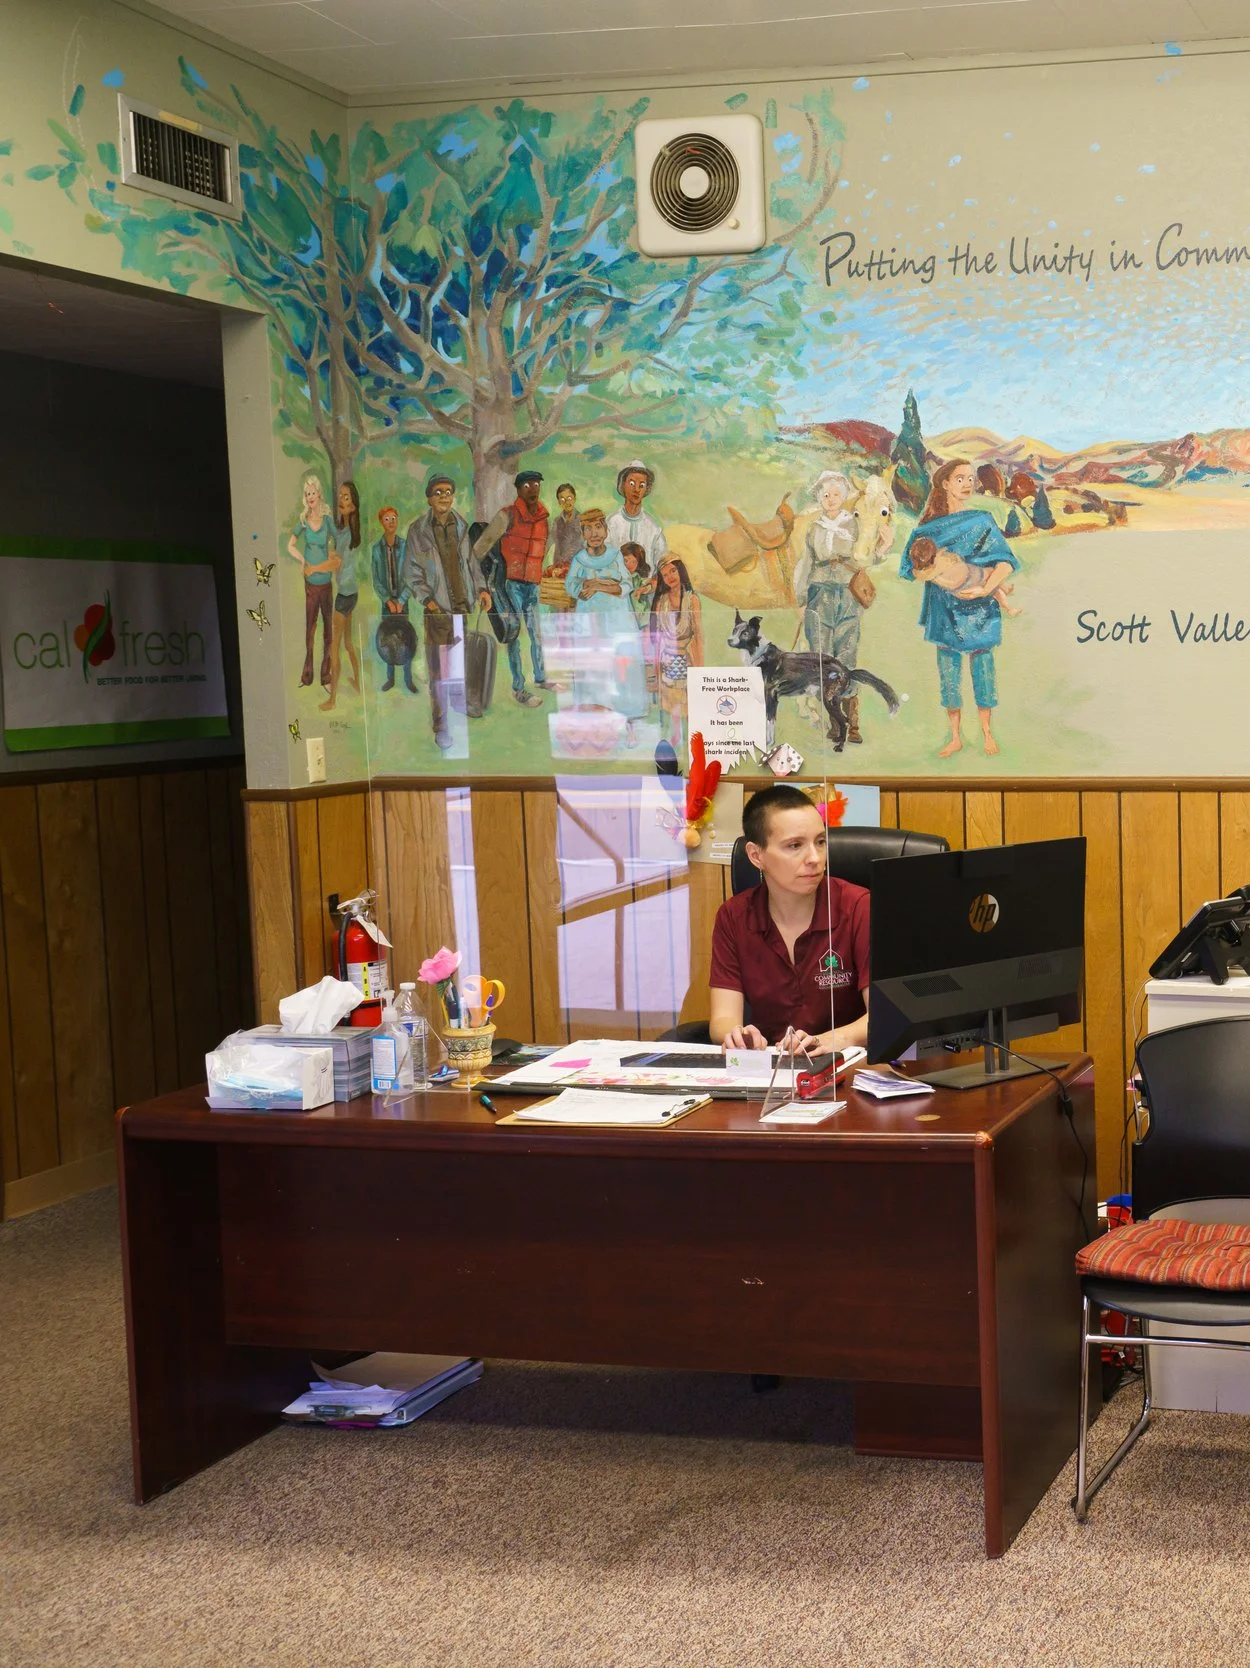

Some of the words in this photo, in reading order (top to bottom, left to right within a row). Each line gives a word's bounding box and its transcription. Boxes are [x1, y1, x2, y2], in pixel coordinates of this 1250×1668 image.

[820, 231, 936, 287] Putting
[948, 242, 998, 276] the
[1008, 236, 1095, 282] Unity
[1110, 240, 1143, 272] in
[14, 620, 71, 670] cal
[119, 620, 206, 667] fresh
[1076, 609, 1152, 644] Scott
[717, 685, 750, 693] Workplace
